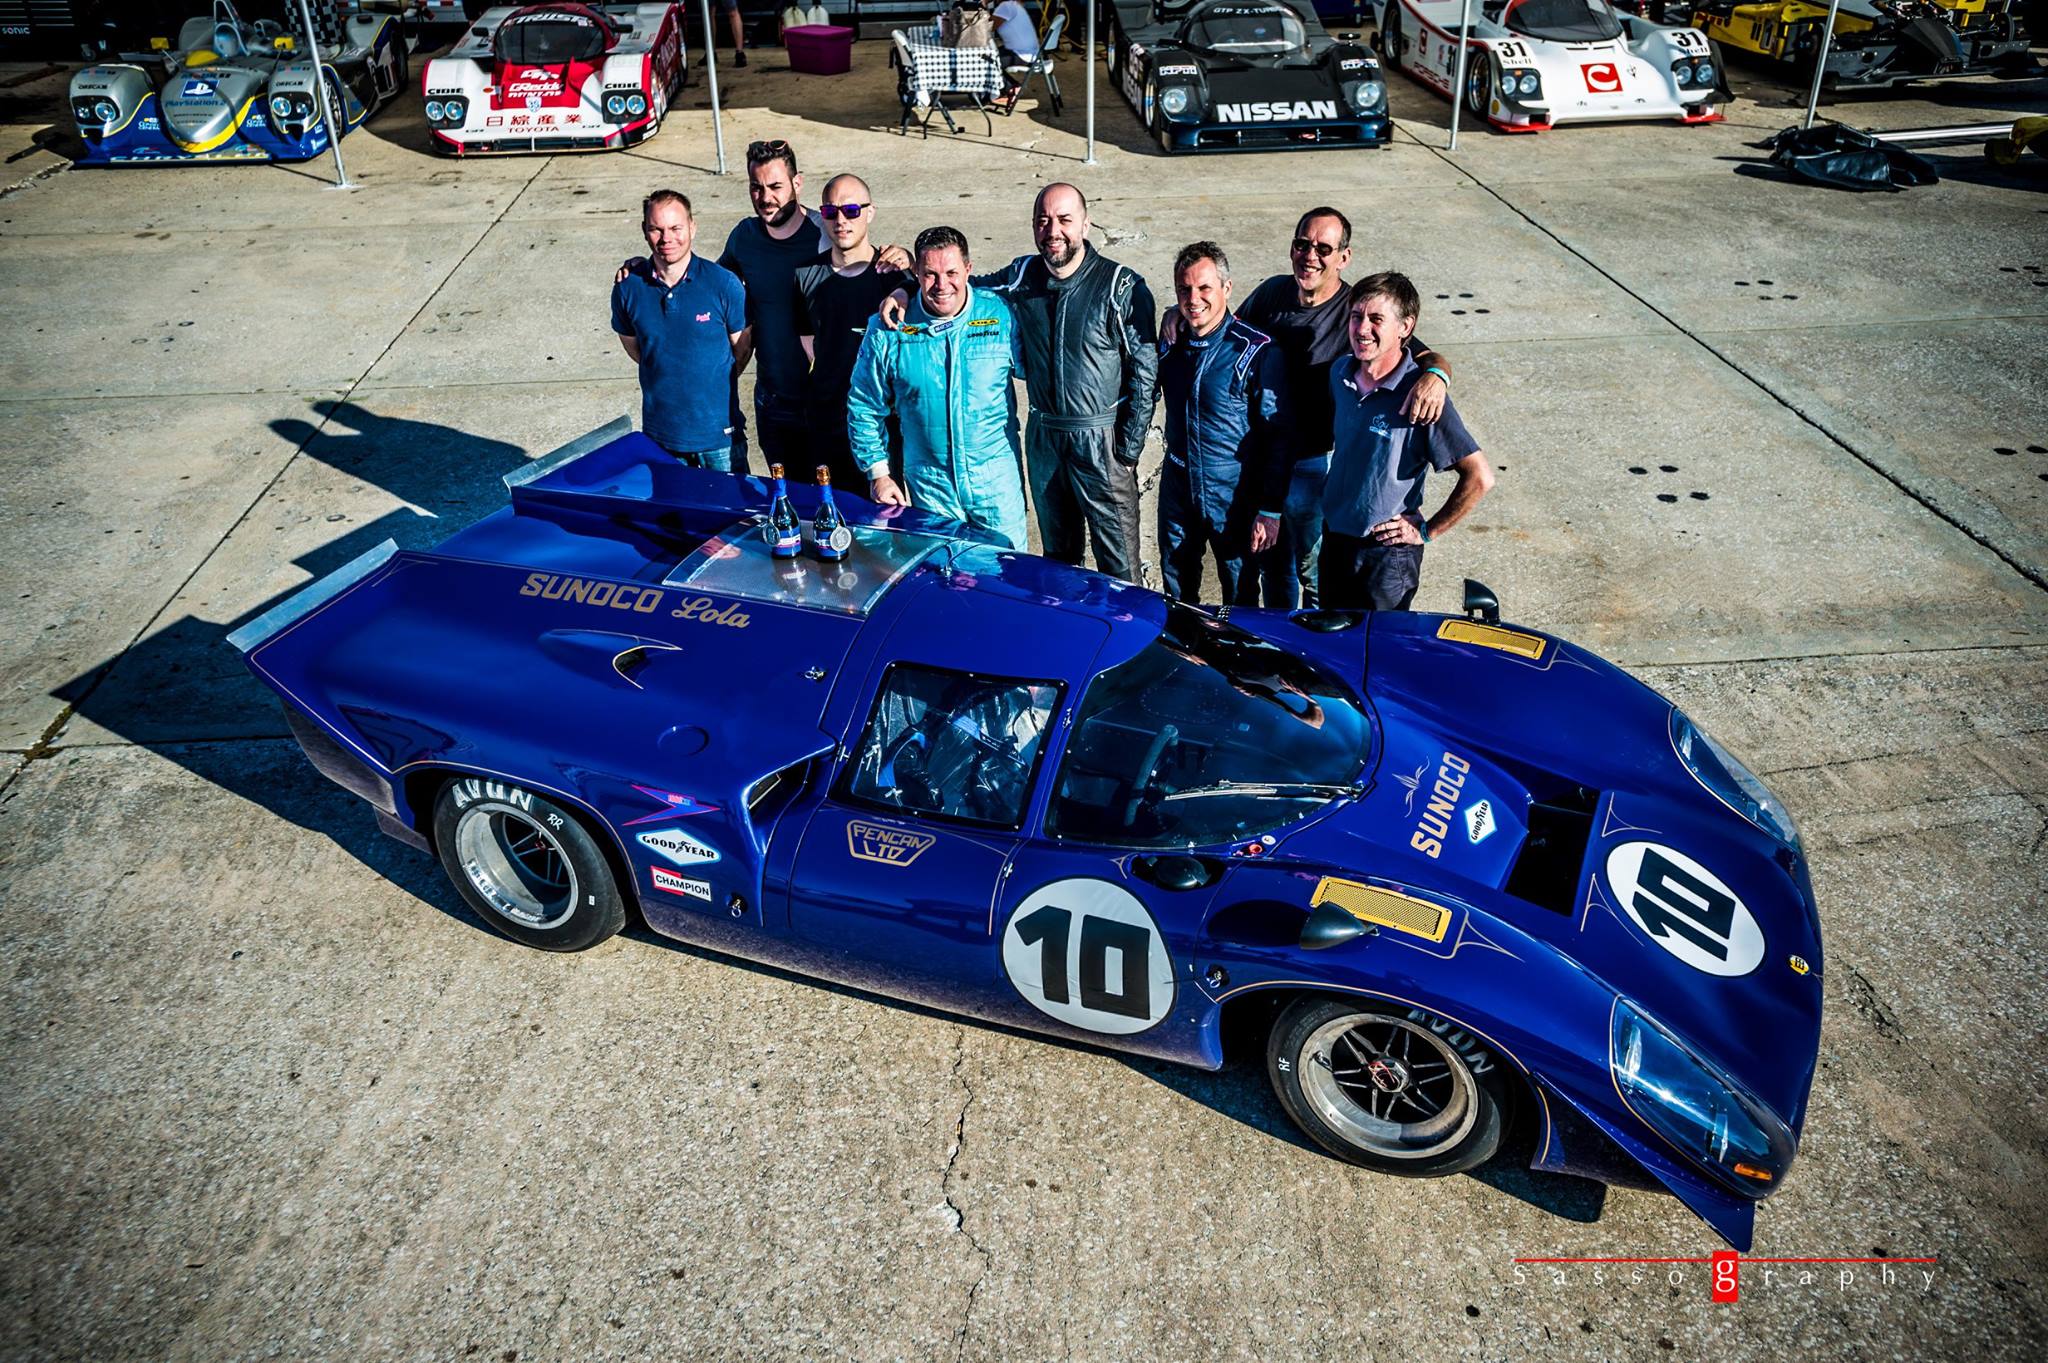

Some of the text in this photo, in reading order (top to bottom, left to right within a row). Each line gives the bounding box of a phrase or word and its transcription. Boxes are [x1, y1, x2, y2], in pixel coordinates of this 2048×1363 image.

[1498, 41, 1526, 57] 31
[1673, 31, 1703, 47] 31
[1217, 101, 1338, 122] NISSAN
[508, 126, 560, 134] TOYOTA
[519, 573, 750, 628] SUNOCO Lola
[1410, 751, 1471, 859] SUNOCO
[547, 813, 564, 831] RR
[641, 835, 715, 859] GOODYEAR
[853, 824, 930, 849] PENCAN
[863, 840, 906, 860] LTD
[655, 874, 710, 896] CHAMPION
[1632, 847, 1736, 962] 10
[1014, 904, 1151, 1021] 10
